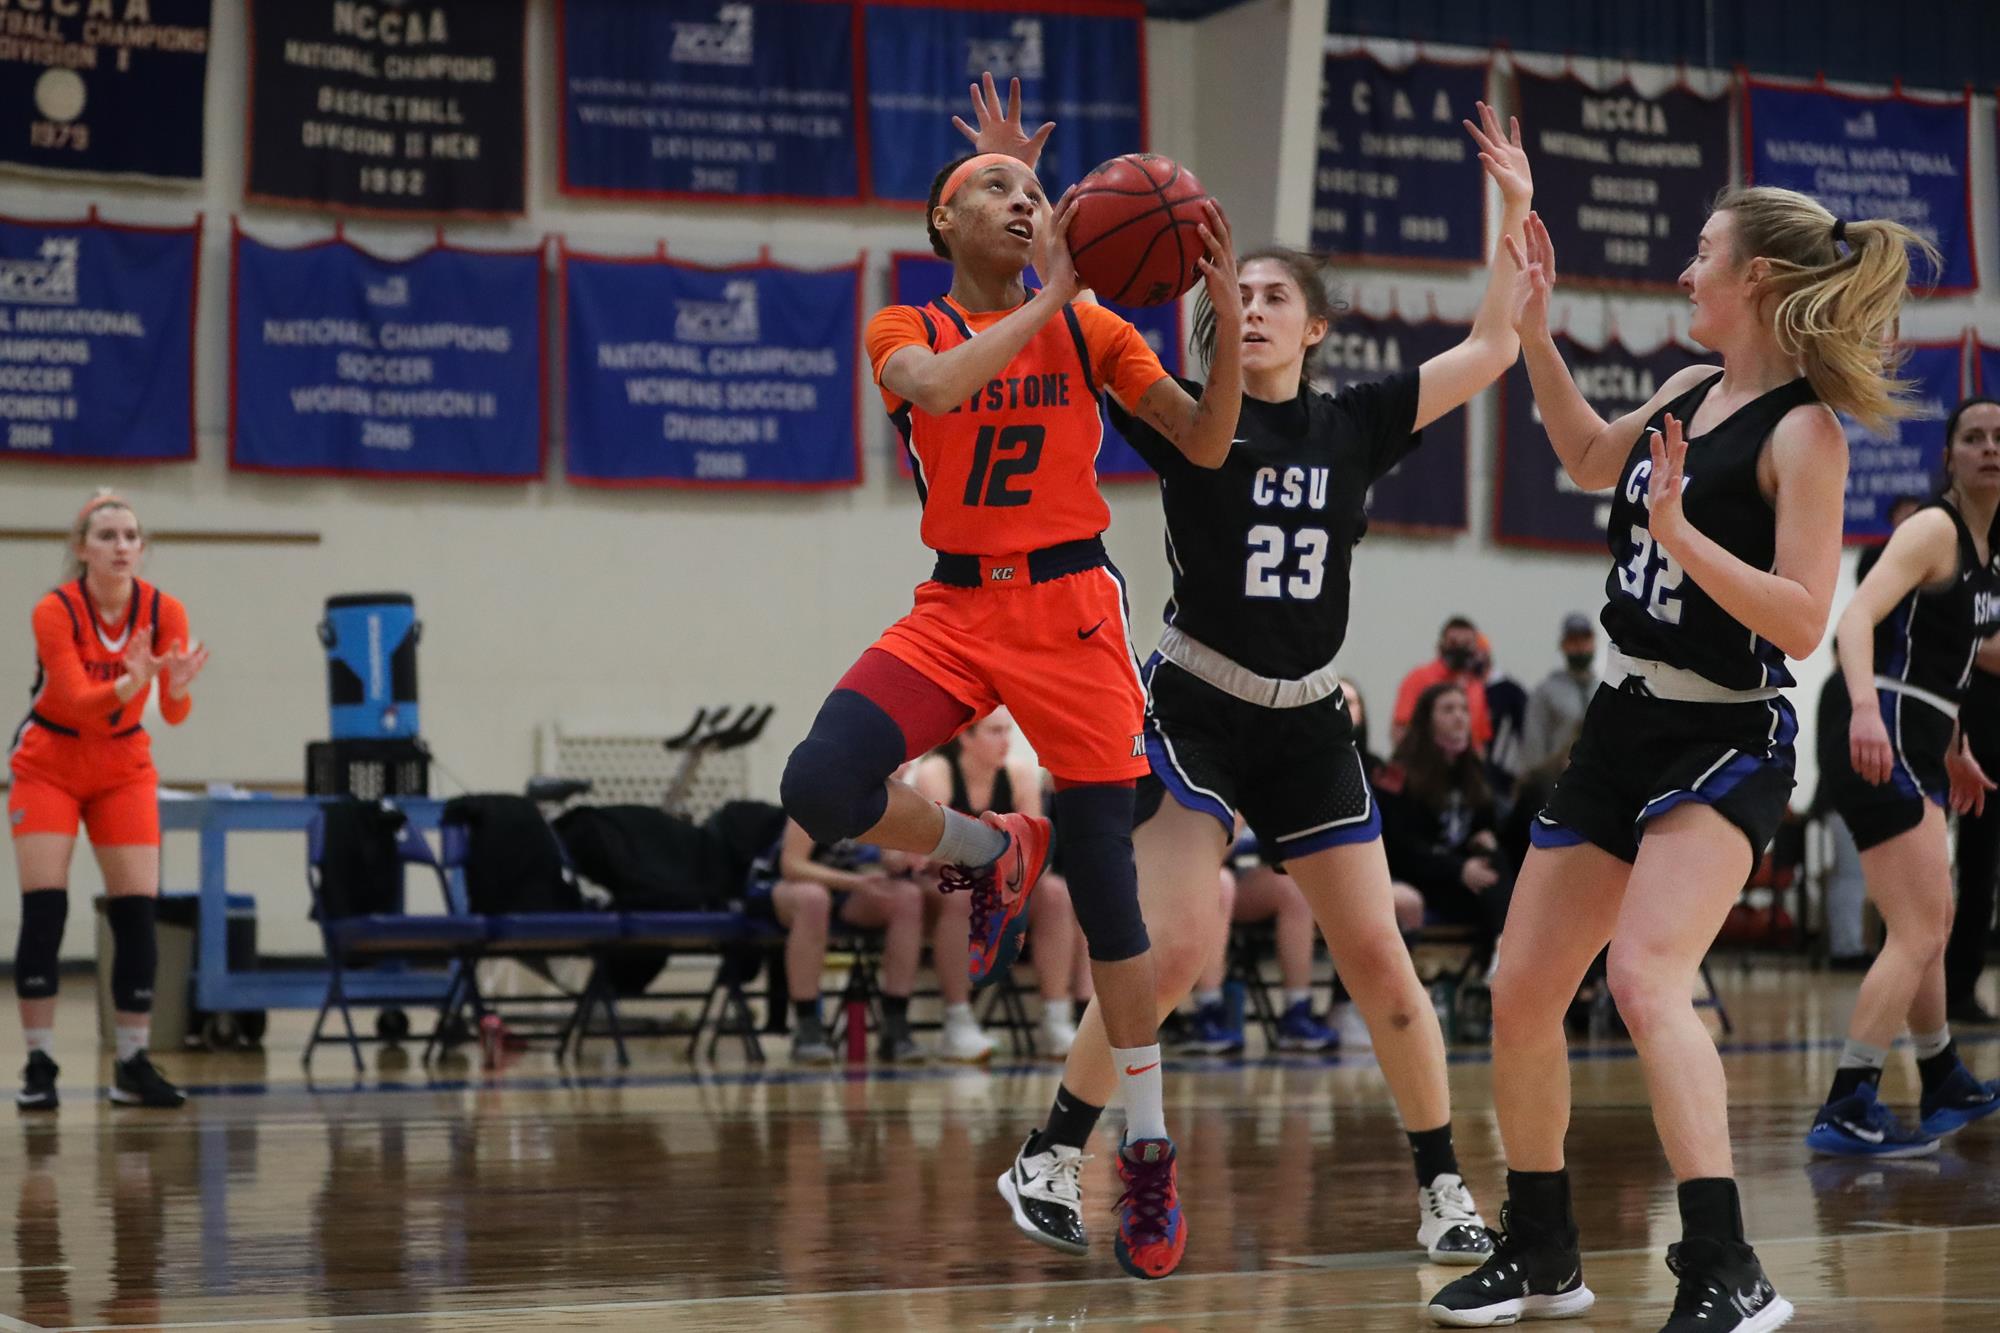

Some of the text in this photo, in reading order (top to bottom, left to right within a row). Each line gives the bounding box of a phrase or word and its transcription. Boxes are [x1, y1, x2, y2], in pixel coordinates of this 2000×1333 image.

[82, 21, 207, 54] CHAMPIONS
[332, 0, 449, 45] NCCAA
[284, 39, 495, 83] NATIONAL CHAMPIONS
[317, 85, 465, 125] BASKETBALL
[1580, 96, 1669, 135] NCCAA
[302, 120, 396, 157] DIVISION
[431, 132, 481, 160] MEN
[262, 319, 510, 353] NATIONAL CHAMPIONS
[336, 352, 434, 384] SOCCER
[597, 342, 837, 377] NATIONAL CHAMPIONS
[725, 381, 818, 411] SOCCER
[948, 372, 1070, 414] YSTONE
[662, 412, 759, 444] DIVISION
[962, 424, 1046, 507] 12
[1252, 466, 1330, 510] CSU
[991, 567, 1015, 581] KC
[1244, 524, 1329, 600] 23
[1617, 523, 1684, 626] 32
